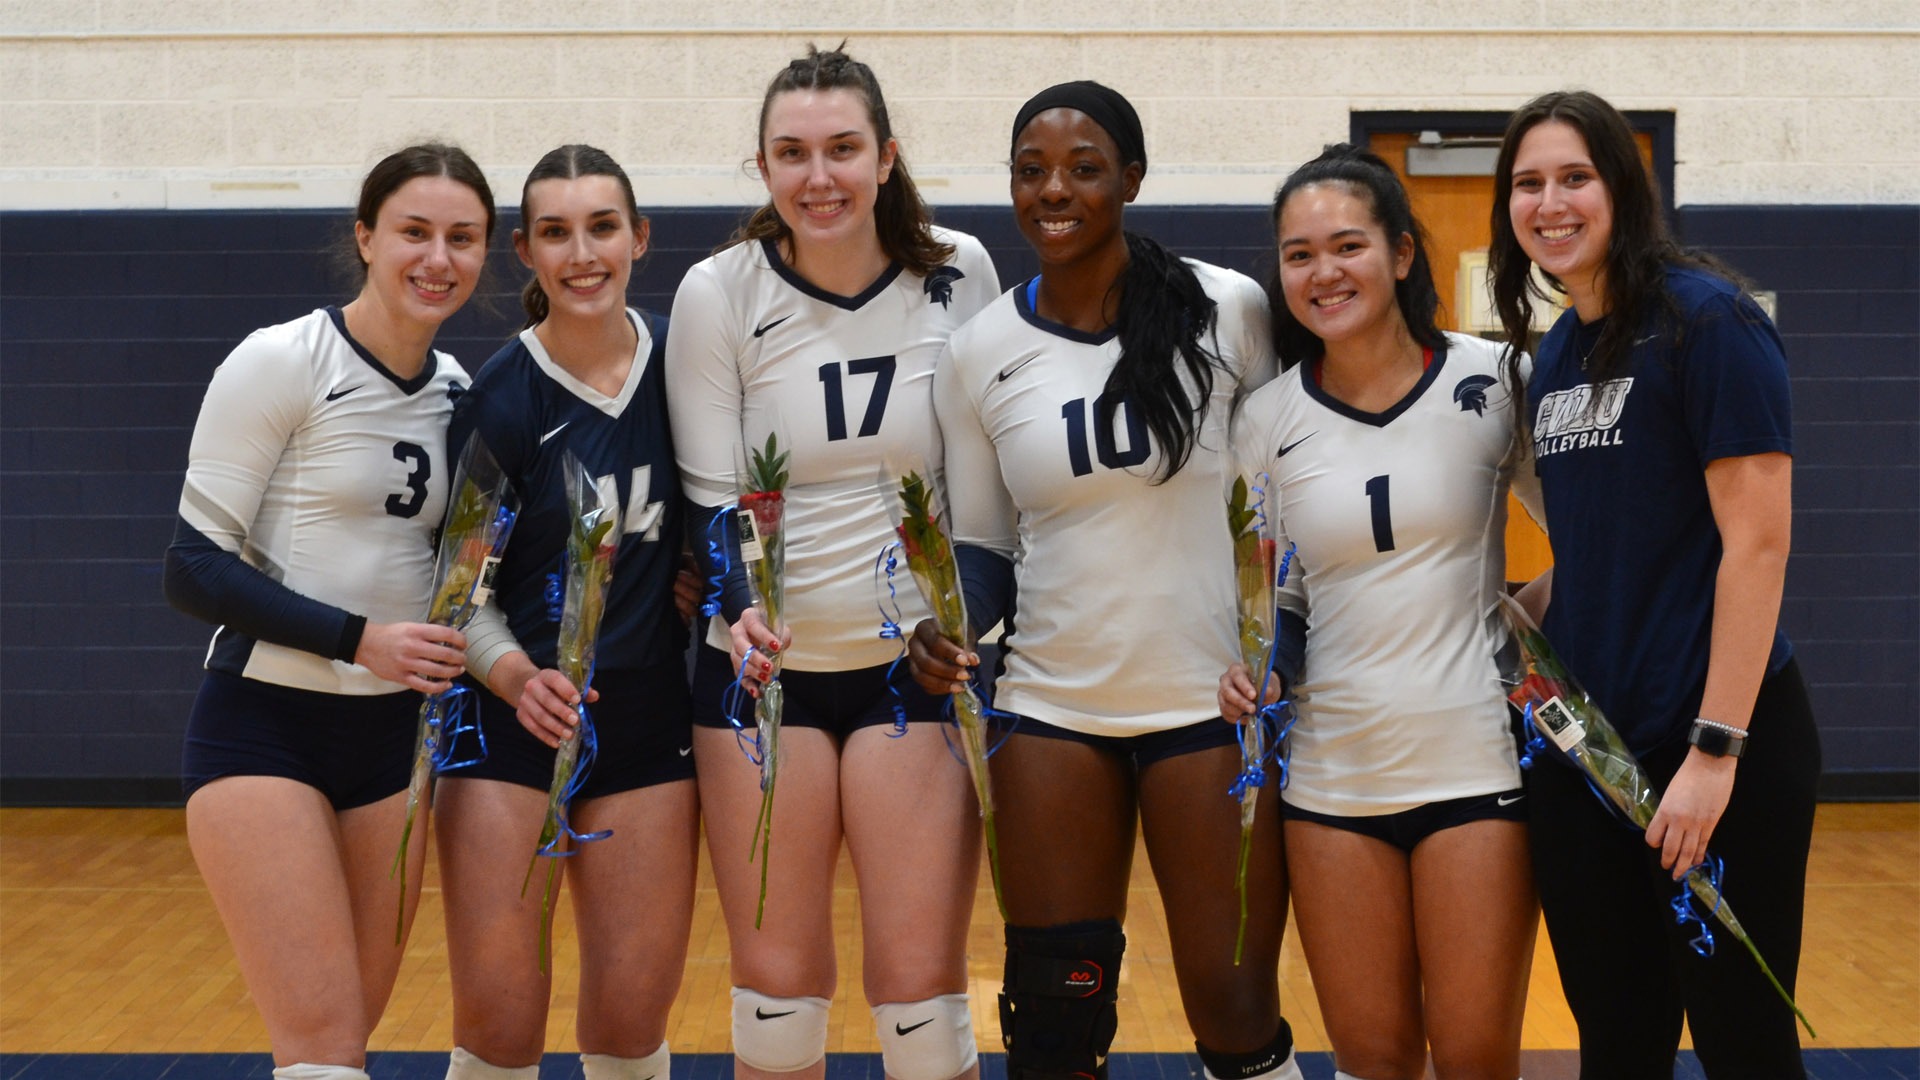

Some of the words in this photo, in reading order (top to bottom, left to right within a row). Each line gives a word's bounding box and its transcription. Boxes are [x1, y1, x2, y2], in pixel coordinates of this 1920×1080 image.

[819, 355, 896, 442] 17
[1062, 391, 1151, 477] 10
[385, 441, 431, 519] 3
[596, 464, 666, 547] 14
[1365, 474, 1395, 553] 1
